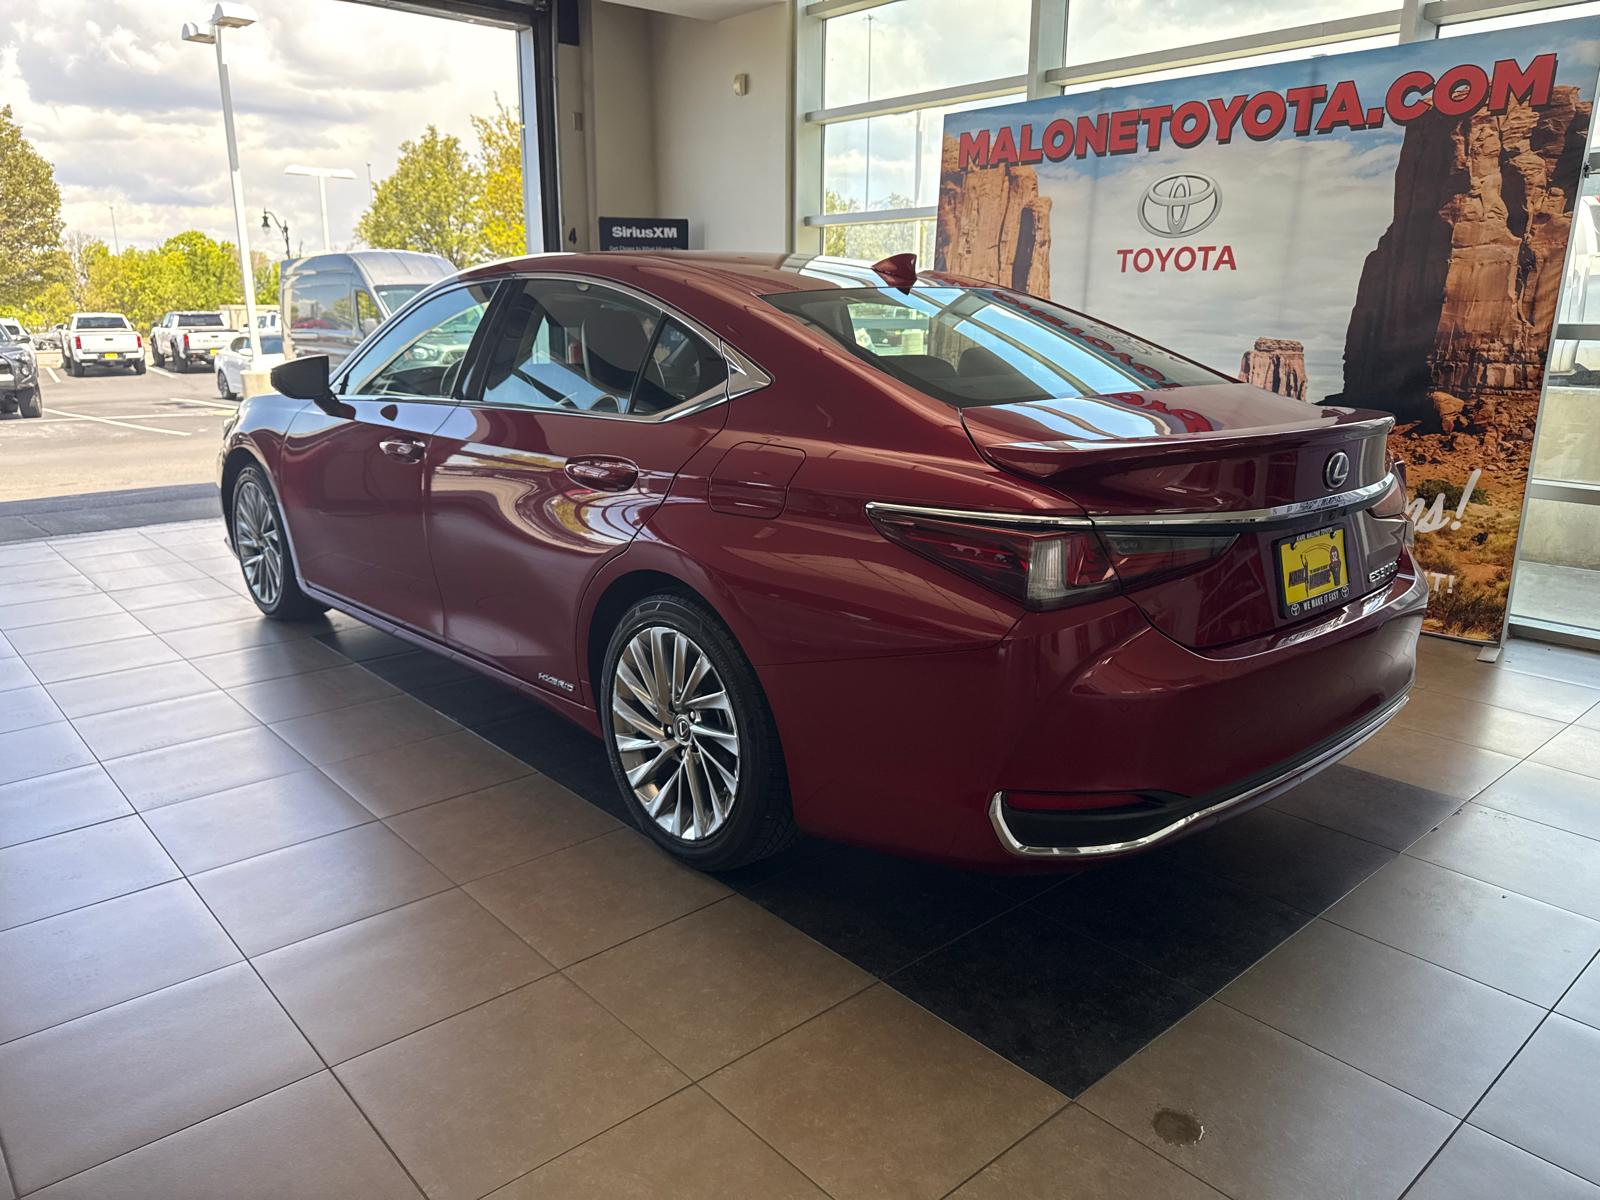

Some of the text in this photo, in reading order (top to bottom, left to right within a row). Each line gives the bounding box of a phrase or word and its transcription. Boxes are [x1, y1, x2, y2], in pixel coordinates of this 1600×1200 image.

[958, 53, 1558, 172] MALONETOYOTA.COM
[568, 227, 577, 245] 4
[612, 226, 677, 239] SiriusXM
[1117, 245, 1237, 273] TOYOTA
[1424, 571, 1455, 594] T!
[1303, 600, 1310, 610] WE
[1311, 597, 1323, 608] MAKE
[1329, 590, 1339, 602] EASY
